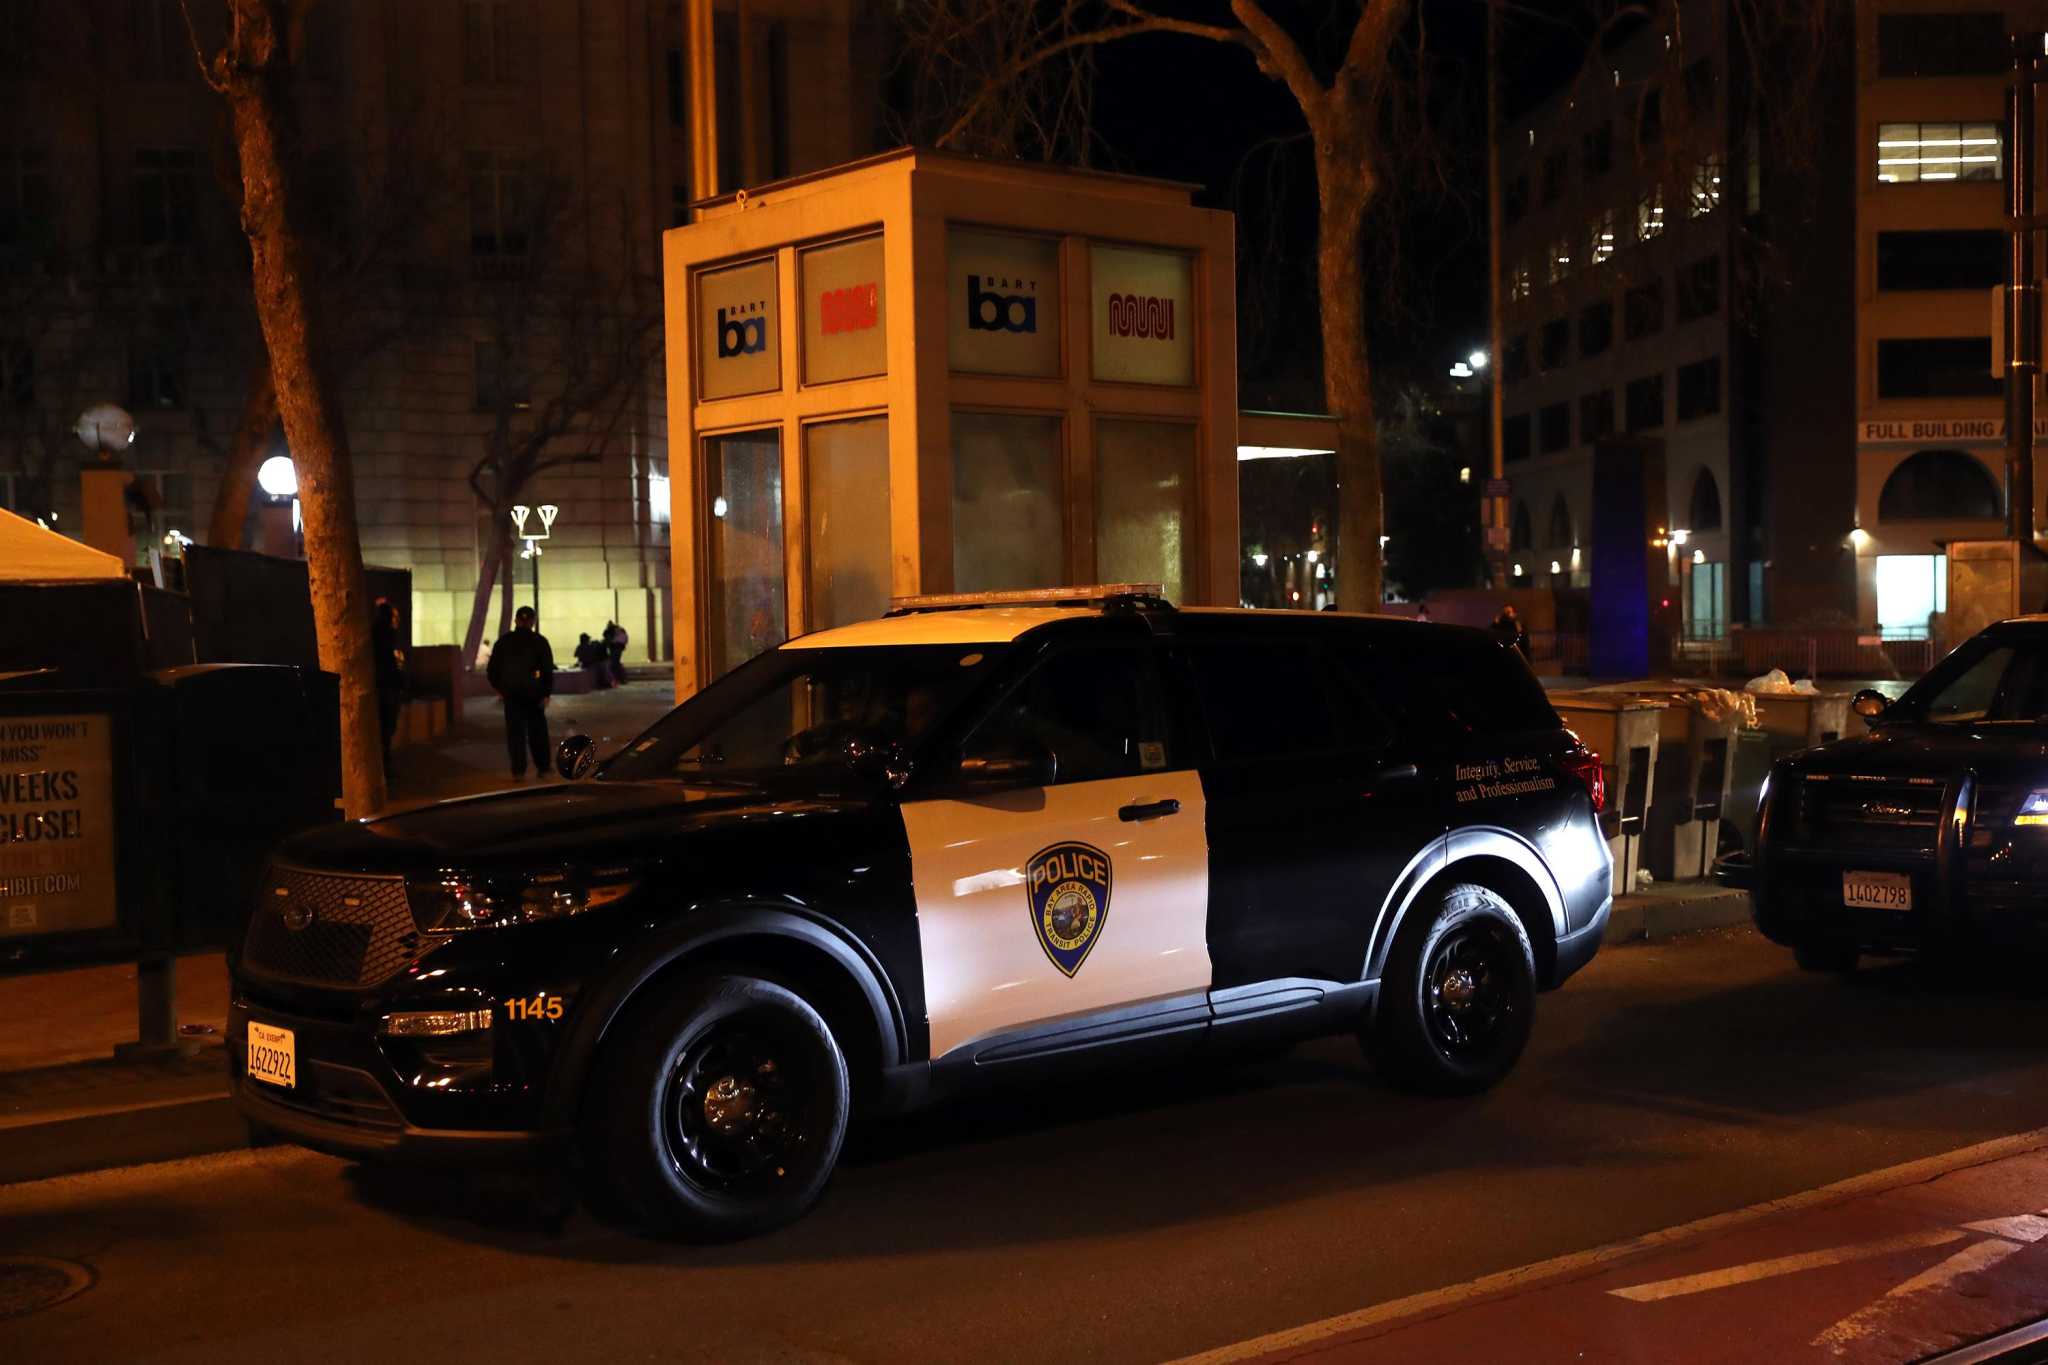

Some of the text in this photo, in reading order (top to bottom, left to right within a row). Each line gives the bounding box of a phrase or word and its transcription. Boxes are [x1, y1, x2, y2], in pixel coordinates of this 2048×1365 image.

[987, 277, 1037, 290] BART
[731, 301, 766, 315] BART
[1866, 424, 1908, 439] FULL
[1912, 421, 1995, 438] BUILDING
[8, 723, 40, 742] YOU
[1456, 785, 1477, 802] and
[1033, 853, 1107, 894] POLICE
[1045, 883, 1096, 916] BAY AREA RAPID
[1848, 884, 1906, 904] 1402798
[1045, 917, 1096, 949] TRANSIT POLICE
[503, 997, 564, 1021] 1145
[250, 1043, 291, 1080] 1622922
